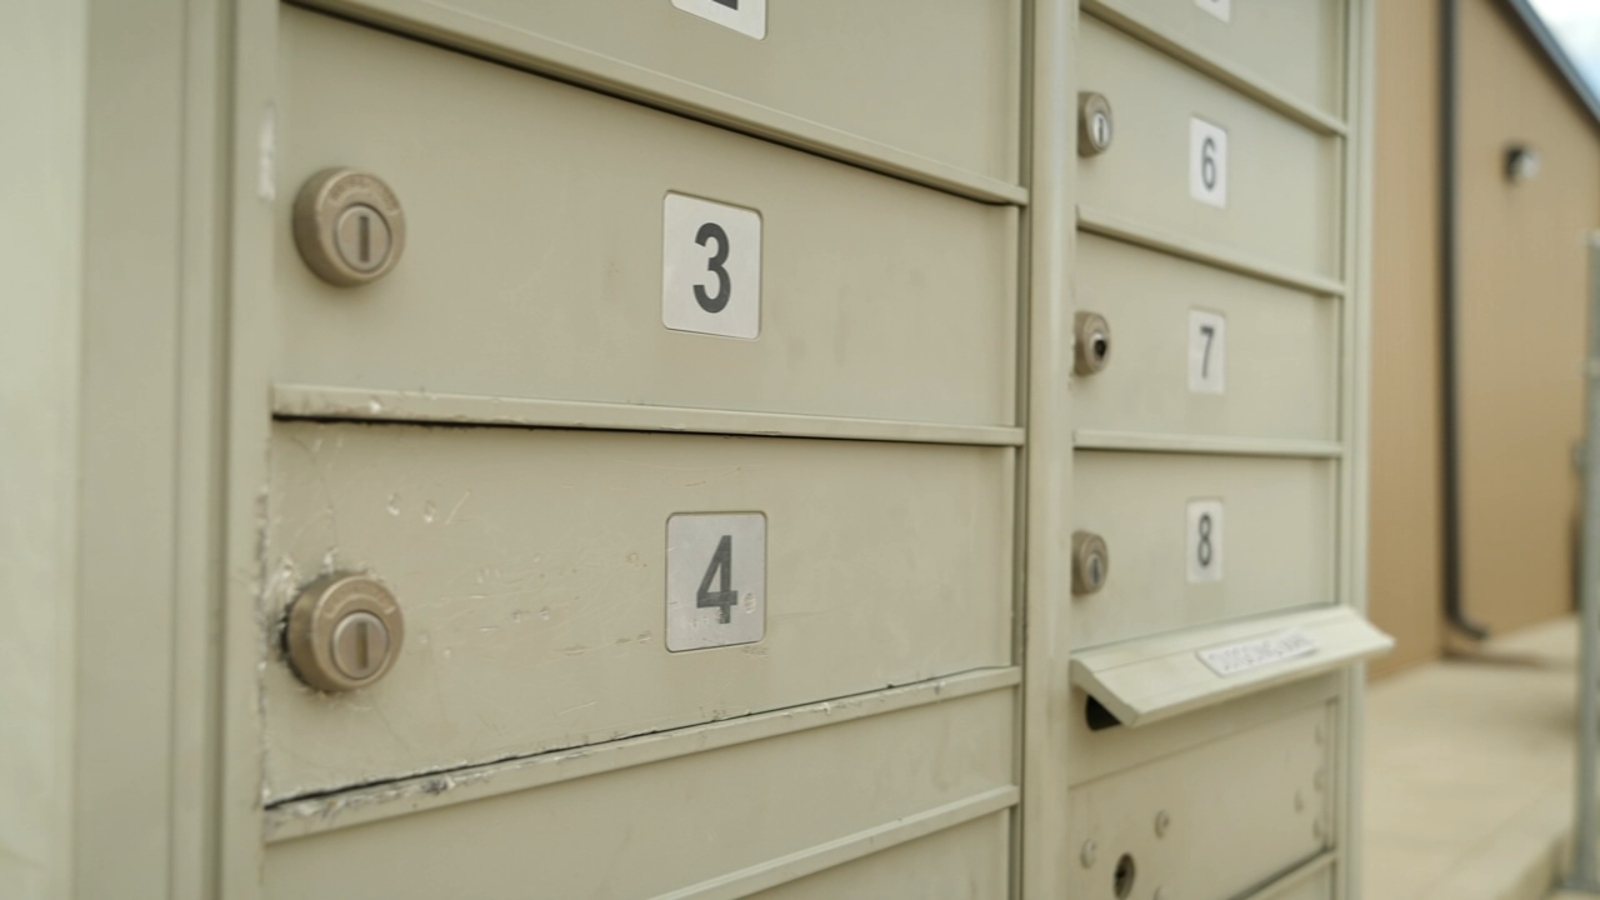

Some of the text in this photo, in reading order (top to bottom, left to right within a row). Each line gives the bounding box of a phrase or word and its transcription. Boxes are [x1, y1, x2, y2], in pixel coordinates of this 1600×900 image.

[1202, 137, 1217, 191] 6
[693, 222, 731, 314] 3
[1200, 325, 1215, 380] 7
[1197, 514, 1212, 568] 8
[696, 534, 738, 625] 4
